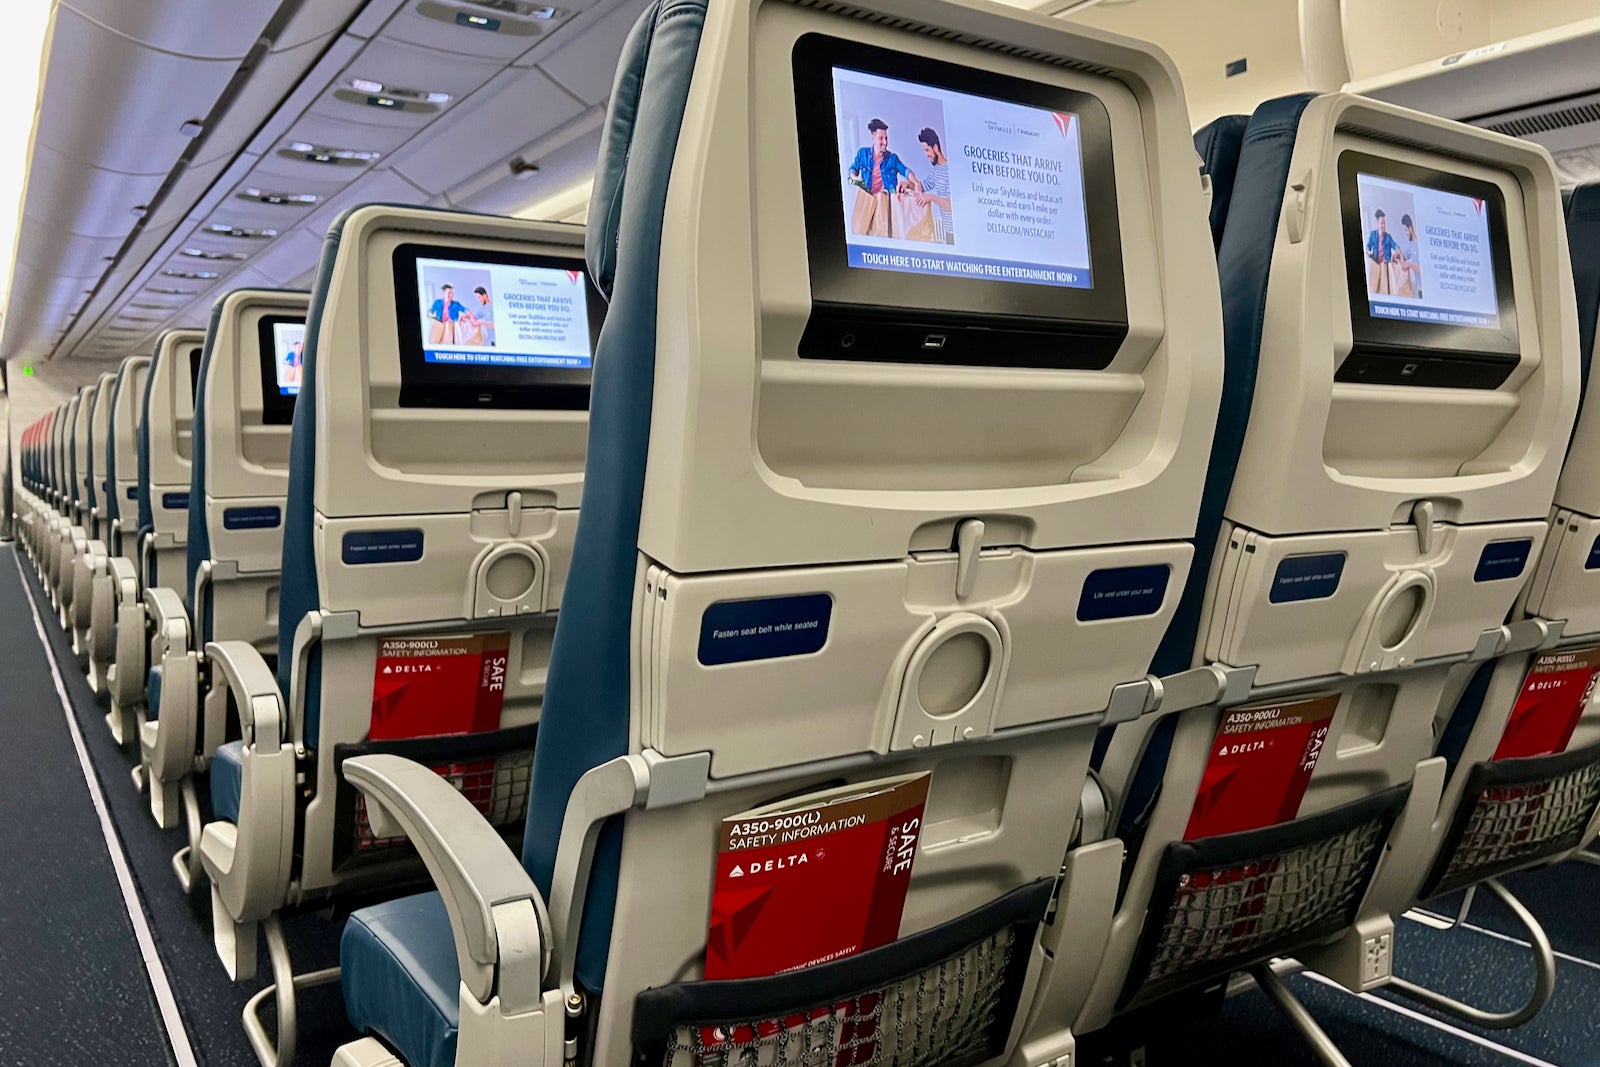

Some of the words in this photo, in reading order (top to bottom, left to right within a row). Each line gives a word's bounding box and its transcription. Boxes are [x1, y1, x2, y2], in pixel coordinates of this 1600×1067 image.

[964, 145, 1009, 163] GROCERIES
[1011, 153, 1032, 166] THAT
[1034, 157, 1062, 172] ARRIVE
[972, 162, 993, 175] EVEN
[996, 165, 1026, 180] BEFORE
[1027, 170, 1044, 183] YOU
[1047, 174, 1060, 186] DO.
[972, 182, 984, 192] Link
[986, 187, 998, 195] your
[1000, 187, 1025, 198] SkyMiles
[1027, 192, 1037, 200] and
[1039, 192, 1062, 204] Instacart
[1006, 201, 1017, 209] and
[988, 208, 1004, 218] dollar
[1006, 212, 1018, 220] with
[1020, 216, 1035, 225] every
[862, 252, 888, 265] TOUCH
[890, 255, 909, 267] HERE
[911, 257, 921, 268] TO
[922, 259, 944, 270] START
[946, 261, 983, 274] WATCHING
[985, 265, 1001, 276] FREE
[1002, 266, 1055, 281] ENTERTAINMENT
[1056, 272, 1072, 282] NOW
[713, 629, 739, 639] Fasten
[740, 627, 757, 636] seat
[758, 625, 773, 634] belt
[774, 622, 793, 632] while
[794, 620, 818, 629] seated
[382, 649, 411, 657] SAFETY
[414, 648, 468, 657] INFORMATION
[383, 640, 438, 649] A350-900(L)
[395, 665, 432, 673] DELTA
[489, 657, 505, 692] SAFE
[1537, 680, 1561, 690] DELTA
[1224, 724, 1253, 734] SAFETY
[1254, 716, 1302, 730] INFORMATION
[1227, 709, 1280, 723] A350-900(L)
[1231, 740, 1265, 754] DELTA
[1303, 726, 1328, 772] SAFE
[729, 833, 777, 850] SAFETY
[781, 814, 866, 842] INFORMATION
[730, 811, 821, 837] A350-900(L)
[883, 835, 897, 872] SECURE
[893, 818, 919, 875] SAFE
[750, 853, 808, 874] DELTA
[808, 953, 834, 967] DEVICES
[834, 945, 856, 958] SAFELY
